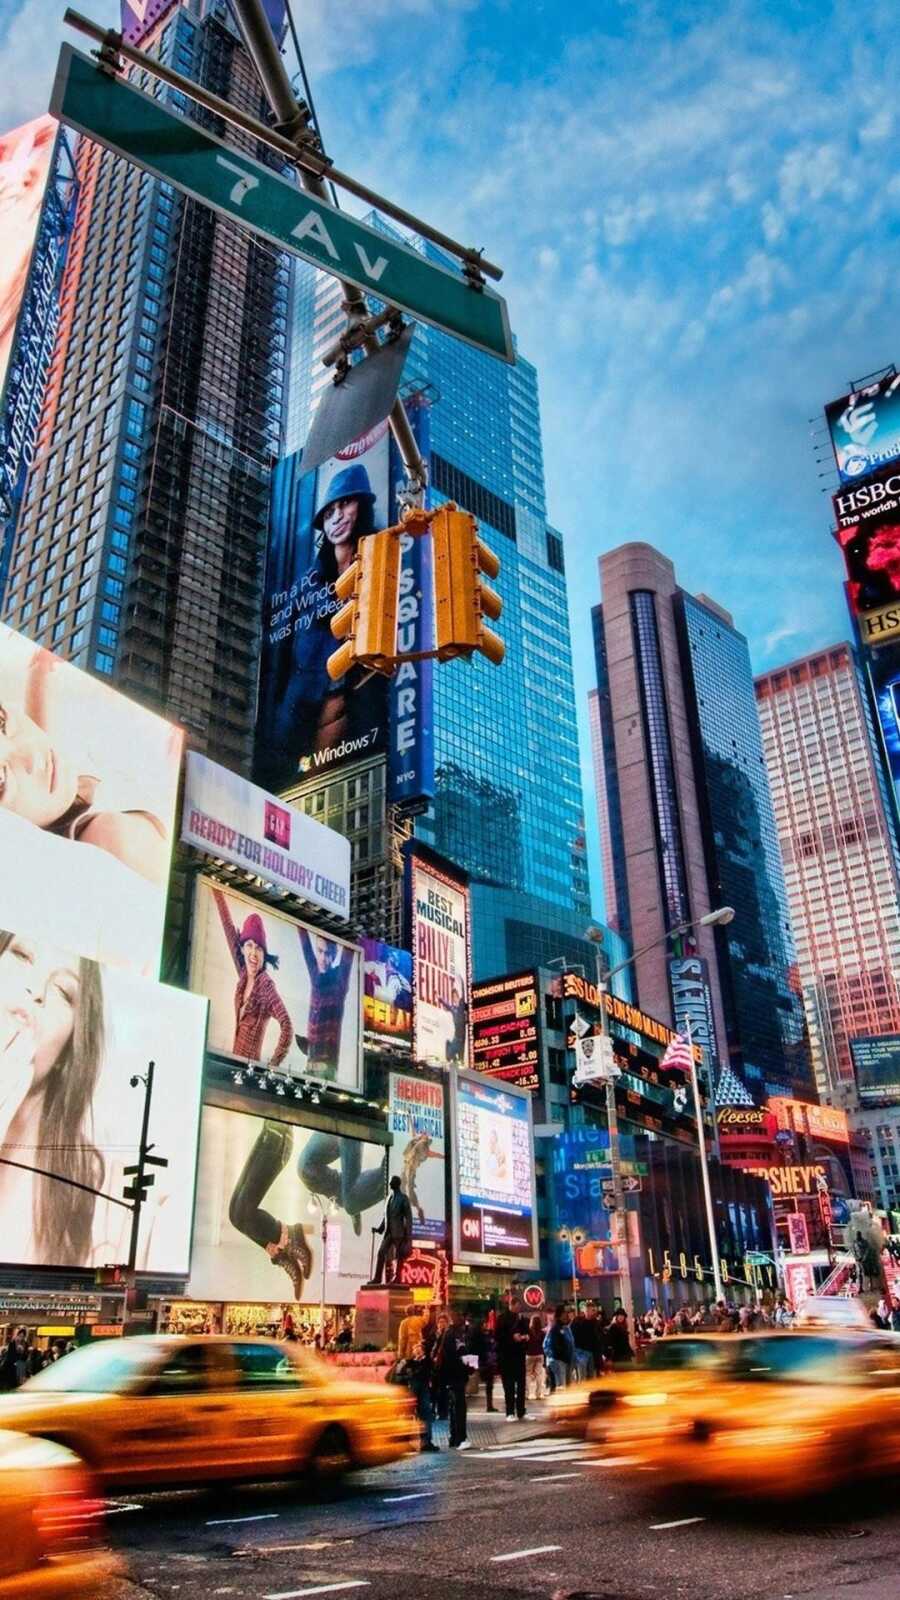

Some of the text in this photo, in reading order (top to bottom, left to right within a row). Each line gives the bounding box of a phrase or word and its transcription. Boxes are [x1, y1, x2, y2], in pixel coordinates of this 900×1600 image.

[216, 154, 260, 206] 7
[4, 321, 42, 490] AMERICAN
[868, 443, 900, 465] Prud
[836, 475, 900, 516] HSBC
[840, 500, 897, 527] The world's
[270, 581, 336, 626] and Windo
[290, 585, 297, 598] a
[269, 623, 291, 644] was
[294, 611, 315, 631] my
[866, 609, 900, 635] HS
[396, 567, 418, 752] SQUARE
[313, 727, 379, 767] Windows 7
[396, 769, 416, 784] NYC
[189, 810, 346, 908] READY FOR HOLIDAY CHEER
[427, 888, 454, 916] BEST
[416, 898, 465, 939] MUSICAL
[418, 920, 449, 972] BILLY
[472, 975, 534, 999] THOMSON REUTERS
[671, 959, 711, 1050] SHEY'S
[397, 1078, 442, 1109] HEIGHTS
[717, 1107, 765, 1124] Reese's
[742, 1165, 826, 1195] SHEY'S
[401, 1262, 435, 1284] ROXY
[528, 1290, 542, 1302] W
